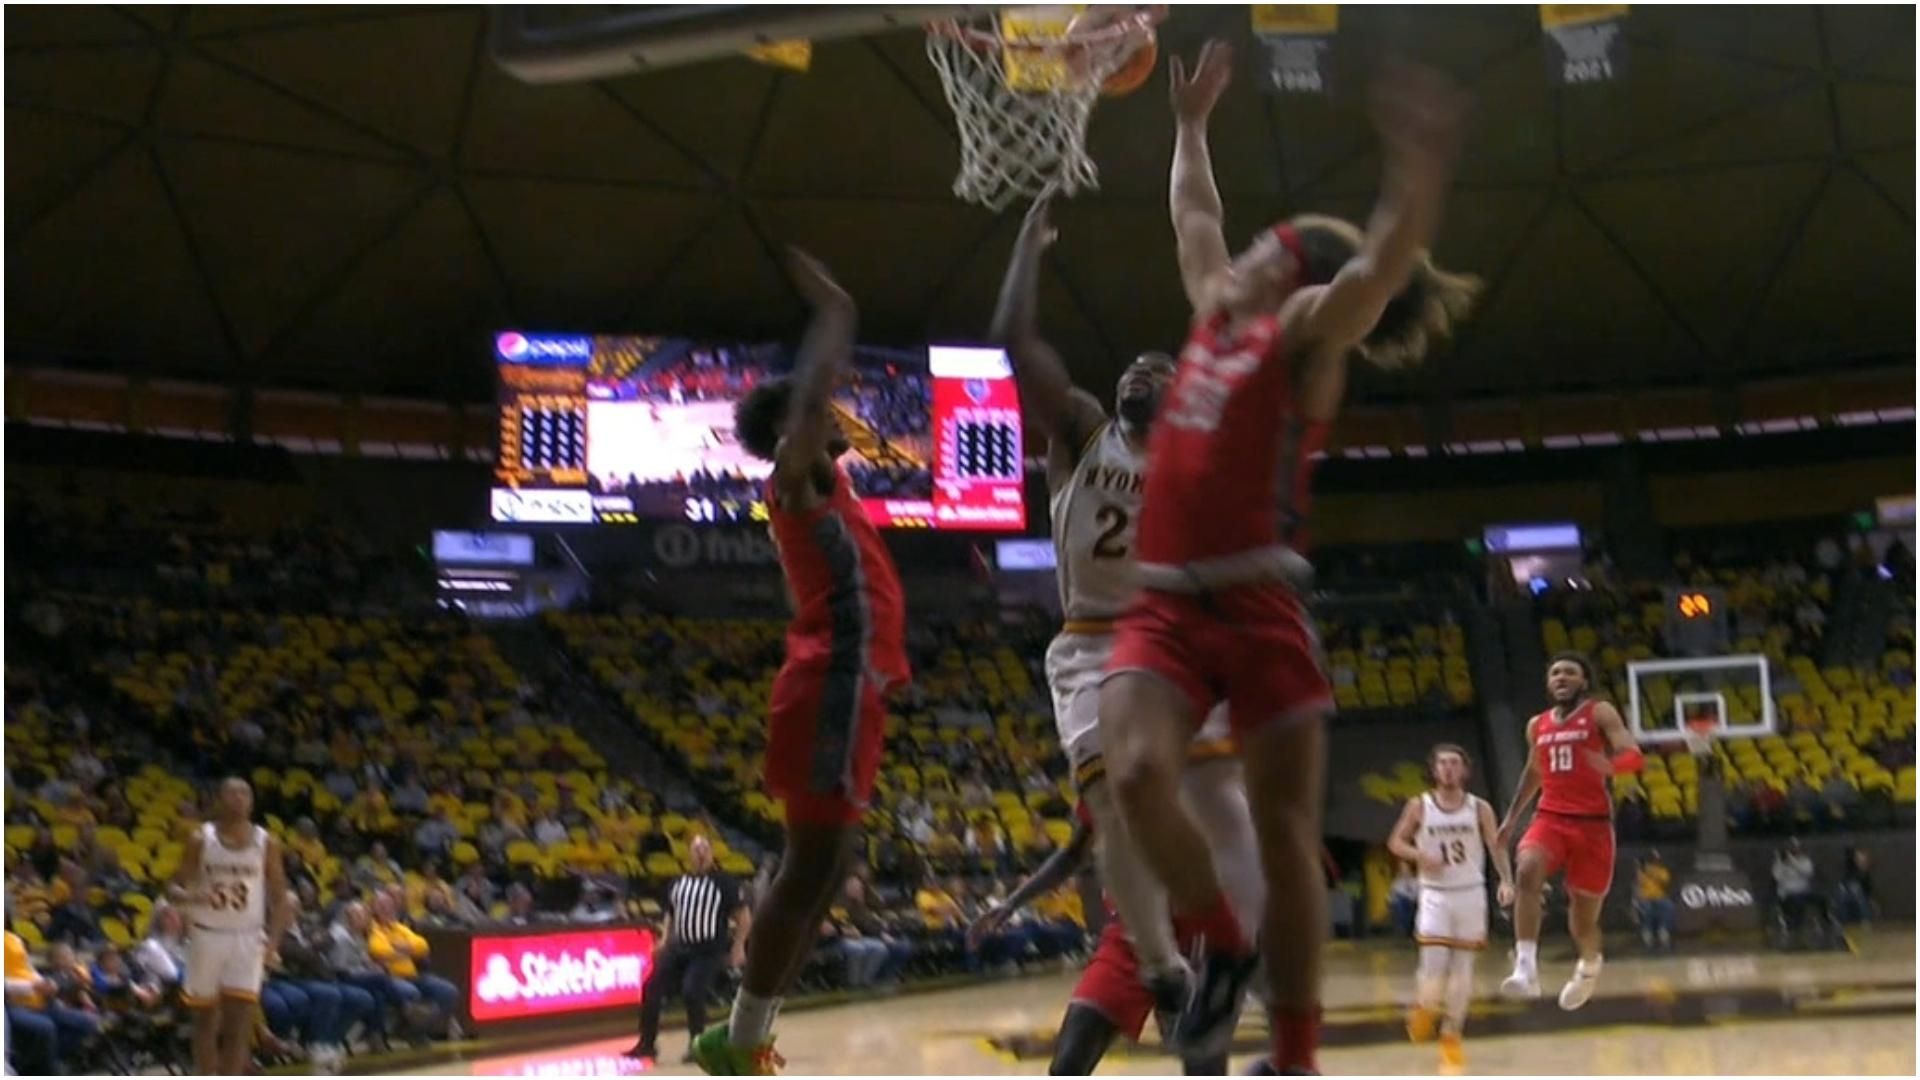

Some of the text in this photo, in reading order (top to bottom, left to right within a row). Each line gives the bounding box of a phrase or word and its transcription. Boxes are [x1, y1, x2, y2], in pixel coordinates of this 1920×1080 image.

[1085, 467, 1144, 494] WYOM
[1093, 505, 1128, 559] 2
[1549, 745, 1573, 773] 10
